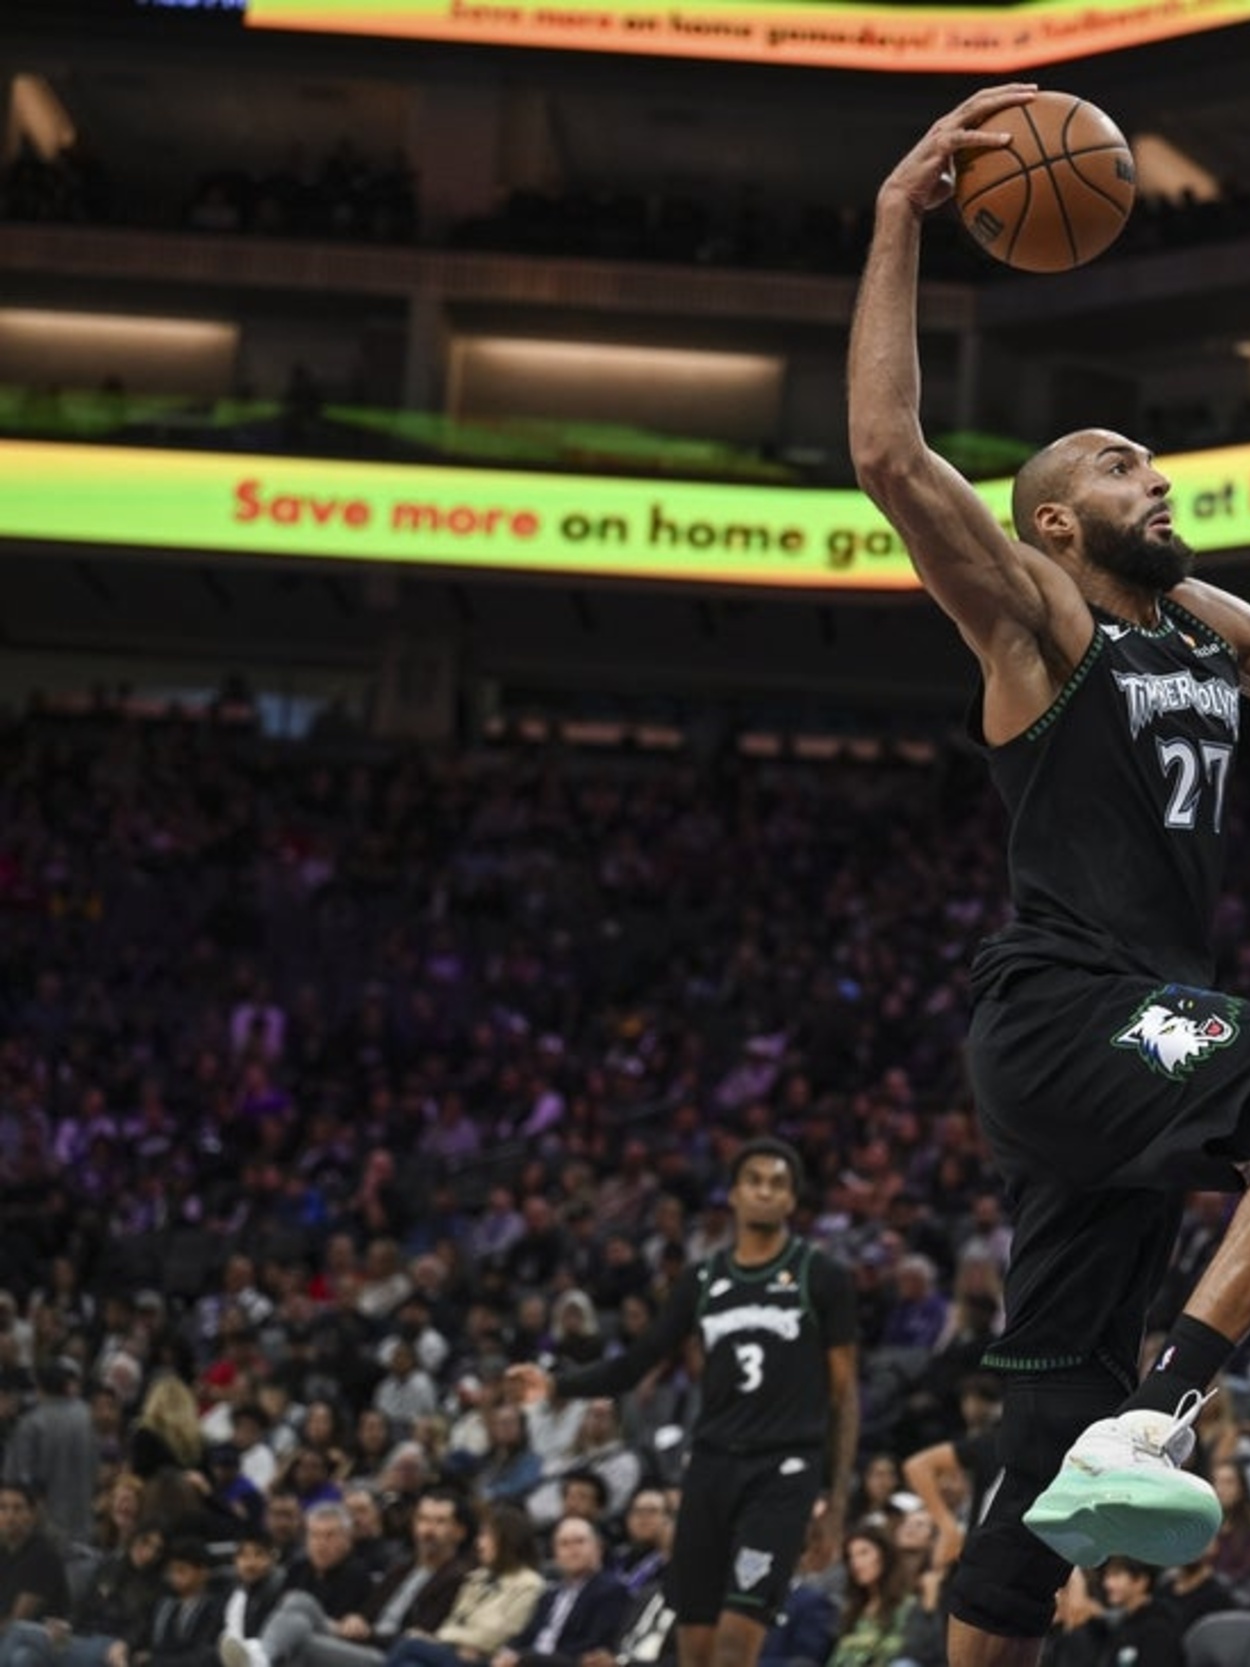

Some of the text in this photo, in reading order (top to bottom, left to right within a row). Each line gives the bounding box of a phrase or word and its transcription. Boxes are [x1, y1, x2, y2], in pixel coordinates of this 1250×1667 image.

[235, 478, 373, 527] Save
[391, 502, 541, 541] more
[559, 513, 629, 544] on
[647, 500, 807, 554] home
[1192, 480, 1235, 520] at
[1155, 735, 1233, 834] 27
[735, 1343, 764, 1393] 3
